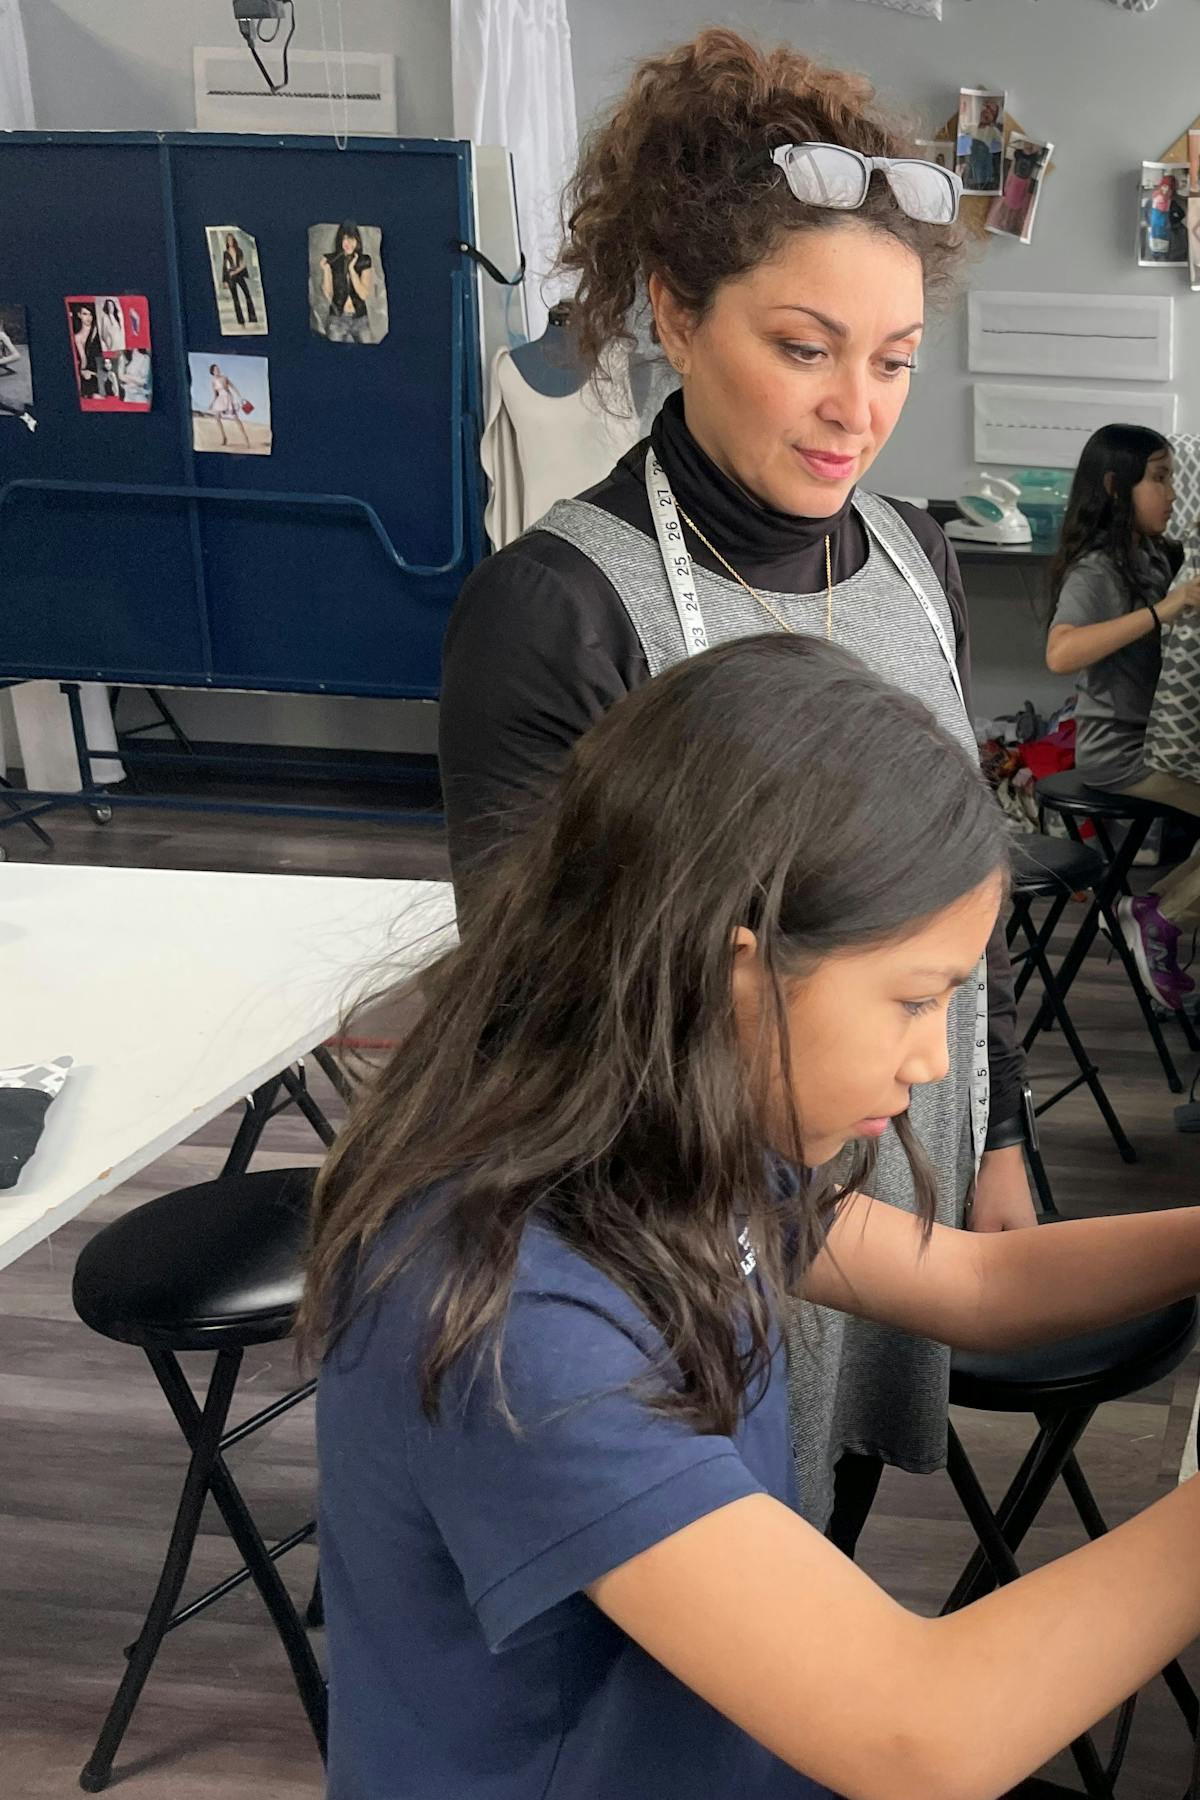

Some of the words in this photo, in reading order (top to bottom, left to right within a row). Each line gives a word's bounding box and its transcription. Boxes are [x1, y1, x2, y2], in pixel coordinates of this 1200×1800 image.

[657, 489, 672, 507] 27
[665, 520, 681, 541] 26
[673, 556, 690, 576] 25
[682, 592, 699, 611] 24
[691, 627, 707, 648] 23
[975, 1040, 986, 1048] 6
[978, 1069, 987, 1077] 5
[980, 1126, 987, 1135] 3
